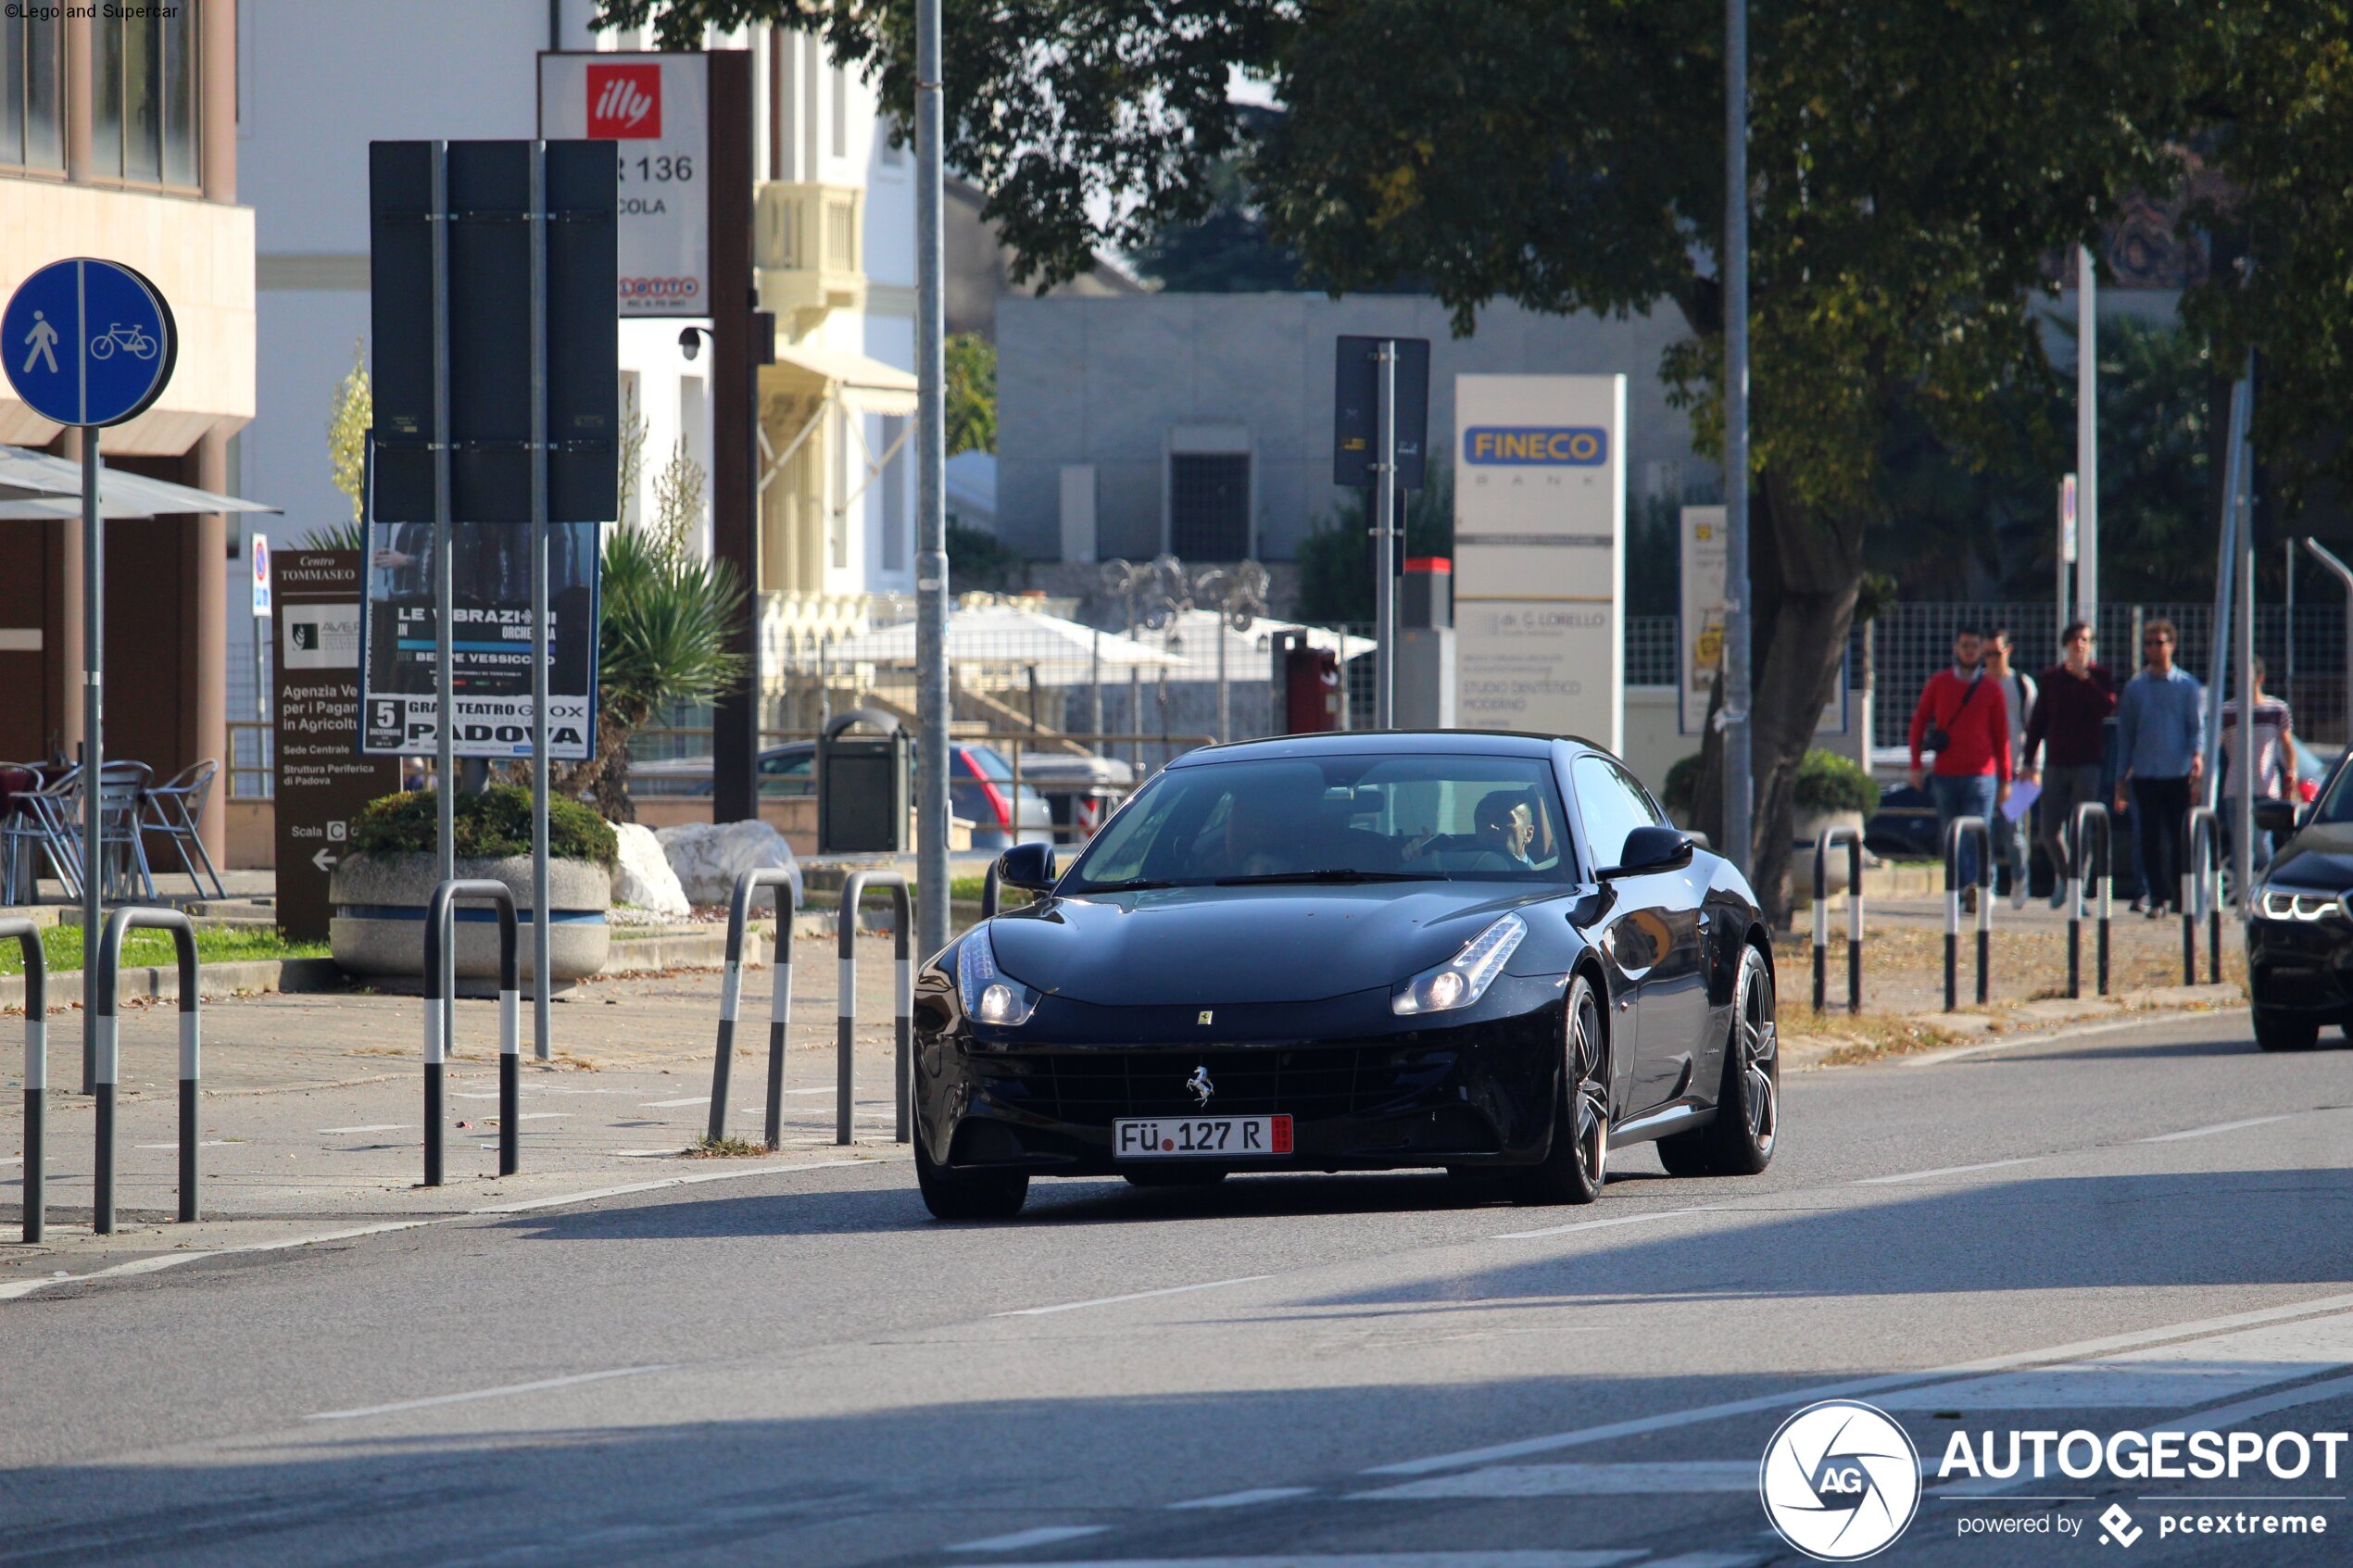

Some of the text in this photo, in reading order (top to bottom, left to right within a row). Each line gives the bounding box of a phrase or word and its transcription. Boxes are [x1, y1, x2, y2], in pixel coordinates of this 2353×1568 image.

[595, 78, 652, 129] illy
[636, 157, 693, 182] 136
[1474, 432, 1599, 460] FINECO
[299, 556, 335, 567] Centro
[281, 569, 356, 582] TOMMASEO
[398, 608, 425, 621] LE
[398, 622, 408, 637] IN
[502, 625, 556, 641] ORCHEA
[416, 652, 465, 664] BEE
[469, 653, 556, 666] VESSICCO
[283, 684, 337, 701] Agenzia
[283, 703, 306, 717] per
[308, 701, 313, 714] i
[376, 701, 396, 728] 5
[455, 702, 516, 716] TEATRO
[518, 704, 585, 718] GOX
[283, 717, 296, 731] in
[369, 727, 402, 737] DICEMBRE
[283, 745, 350, 755] Sede Centrale
[283, 763, 375, 774] Struttura Periferica
[283, 775, 331, 786] di Padova
[291, 824, 323, 838] Scala
[331, 823, 344, 838] C
[1178, 1122, 1231, 1150] 127
[1243, 1121, 1262, 1149] R
